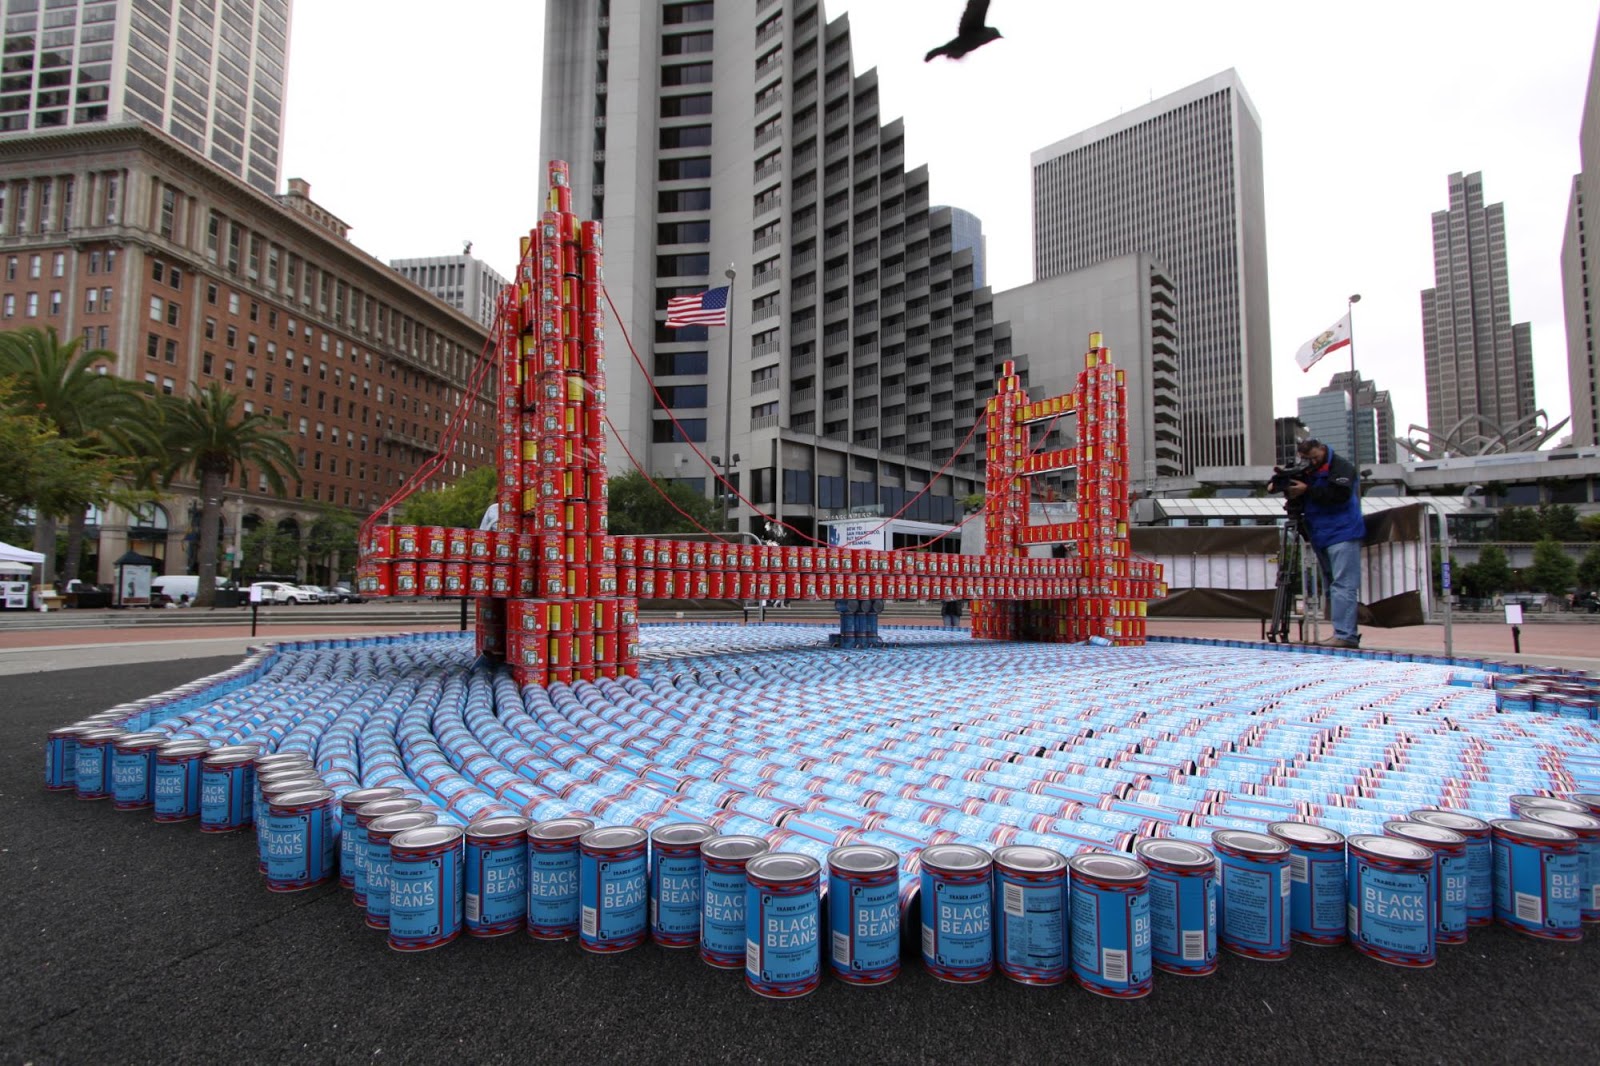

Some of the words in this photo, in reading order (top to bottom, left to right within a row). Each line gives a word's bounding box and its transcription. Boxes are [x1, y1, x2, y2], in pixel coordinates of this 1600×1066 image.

[487, 864, 524, 882] BLAC
[533, 870, 577, 883] BLACK
[390, 880, 433, 895] BLACK
[486, 877, 525, 894] BEAN
[532, 882, 578, 896] BEANS
[662, 876, 700, 891] BLAC
[390, 894, 435, 907] BEANS
[662, 890, 700, 904] BEAN
[706, 892, 746, 908] BLAC
[1366, 887, 1424, 908] BLACK
[706, 905, 744, 922] BEAN
[942, 904, 989, 921] BLACK
[1364, 900, 1425, 922] BEANS
[768, 914, 817, 933] BLACK
[940, 918, 990, 934] BEANS
[767, 928, 818, 948] BEANS
